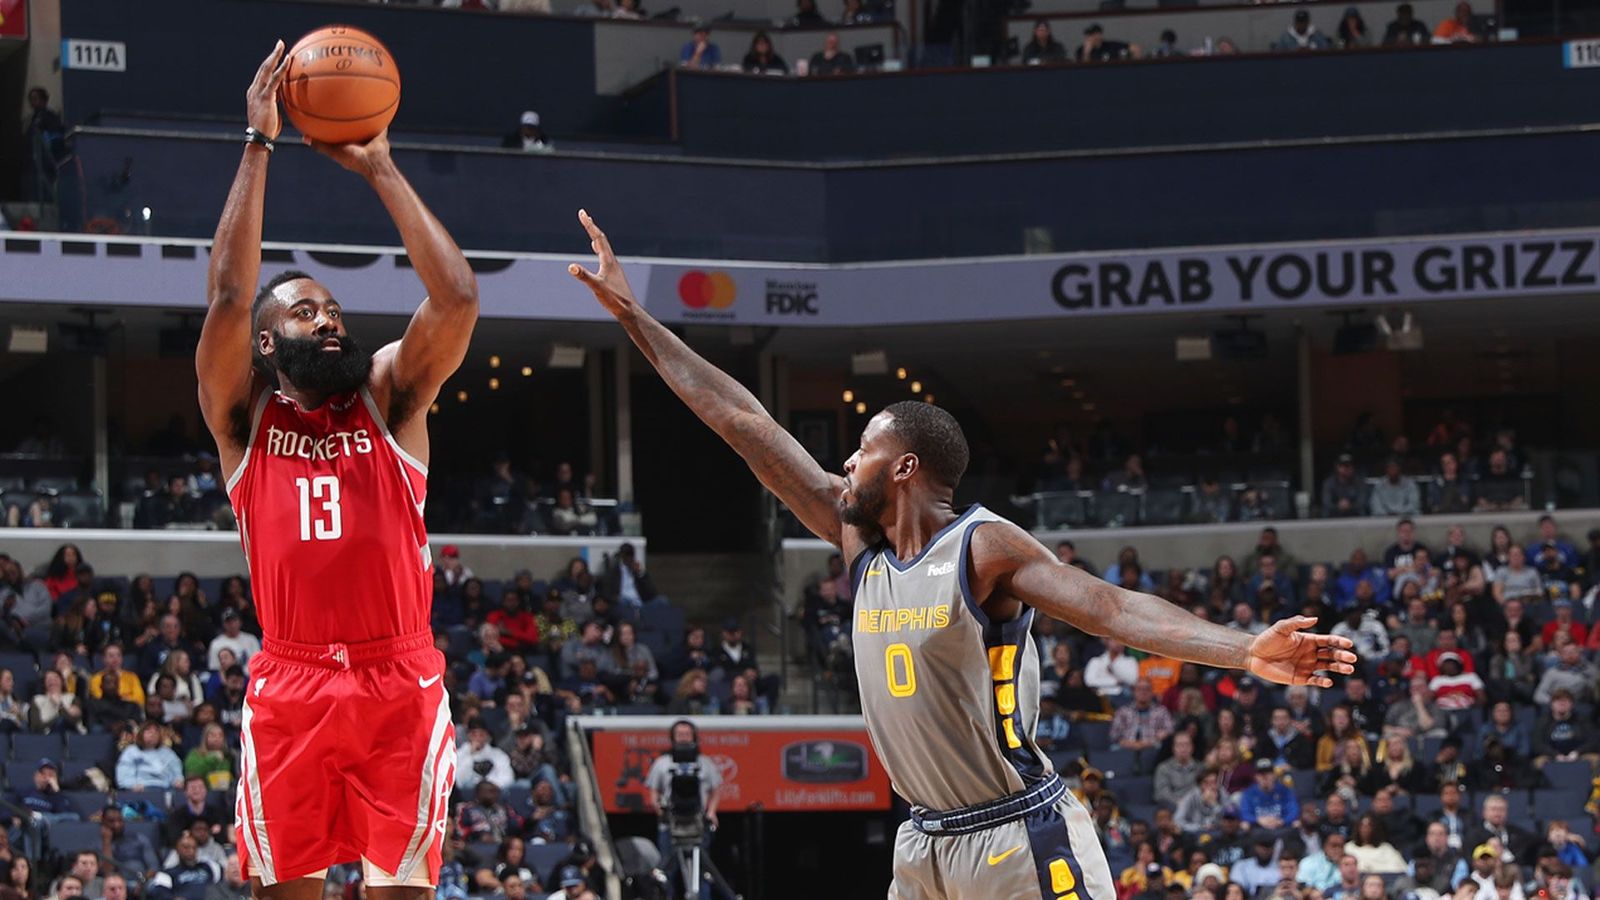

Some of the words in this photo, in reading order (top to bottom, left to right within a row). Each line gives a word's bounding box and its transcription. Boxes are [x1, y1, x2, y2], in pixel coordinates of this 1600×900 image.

[75, 45, 119, 67] 111A
[1051, 259, 1213, 310] GRAB
[1227, 251, 1398, 300] YOUR
[1414, 240, 1597, 293] GRIZZ
[766, 293, 819, 315] FDIC
[266, 425, 373, 461] ROCKETS
[296, 476, 342, 541] 13
[857, 604, 950, 634] MEMPHIS
[885, 643, 916, 698] 0
